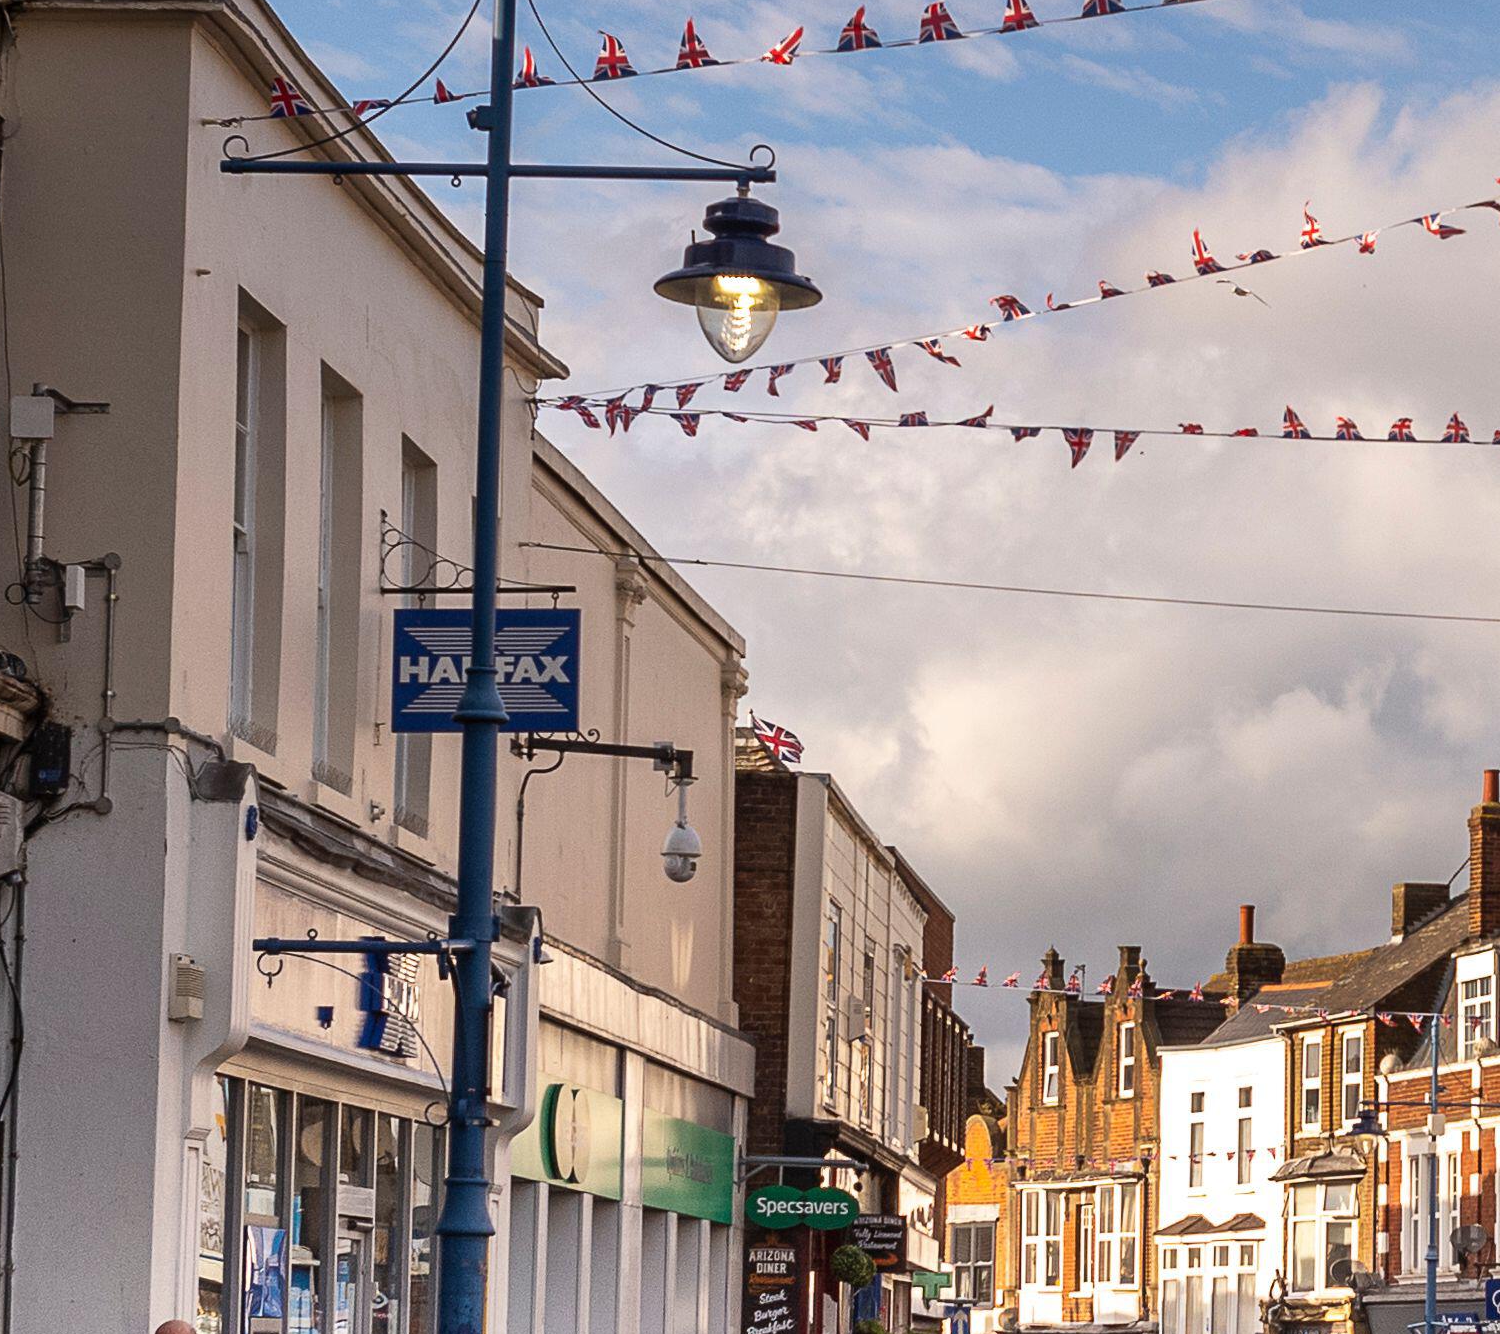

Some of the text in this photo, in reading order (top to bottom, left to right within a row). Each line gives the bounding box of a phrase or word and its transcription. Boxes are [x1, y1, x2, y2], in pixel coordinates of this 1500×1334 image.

[756, 1197, 849, 1217] Specsavers
[749, 1250, 796, 1263] ARIZONA
[756, 1263, 787, 1274] DINER
[759, 1289, 788, 1305] Steak
[753, 1306, 790, 1323] Burger
